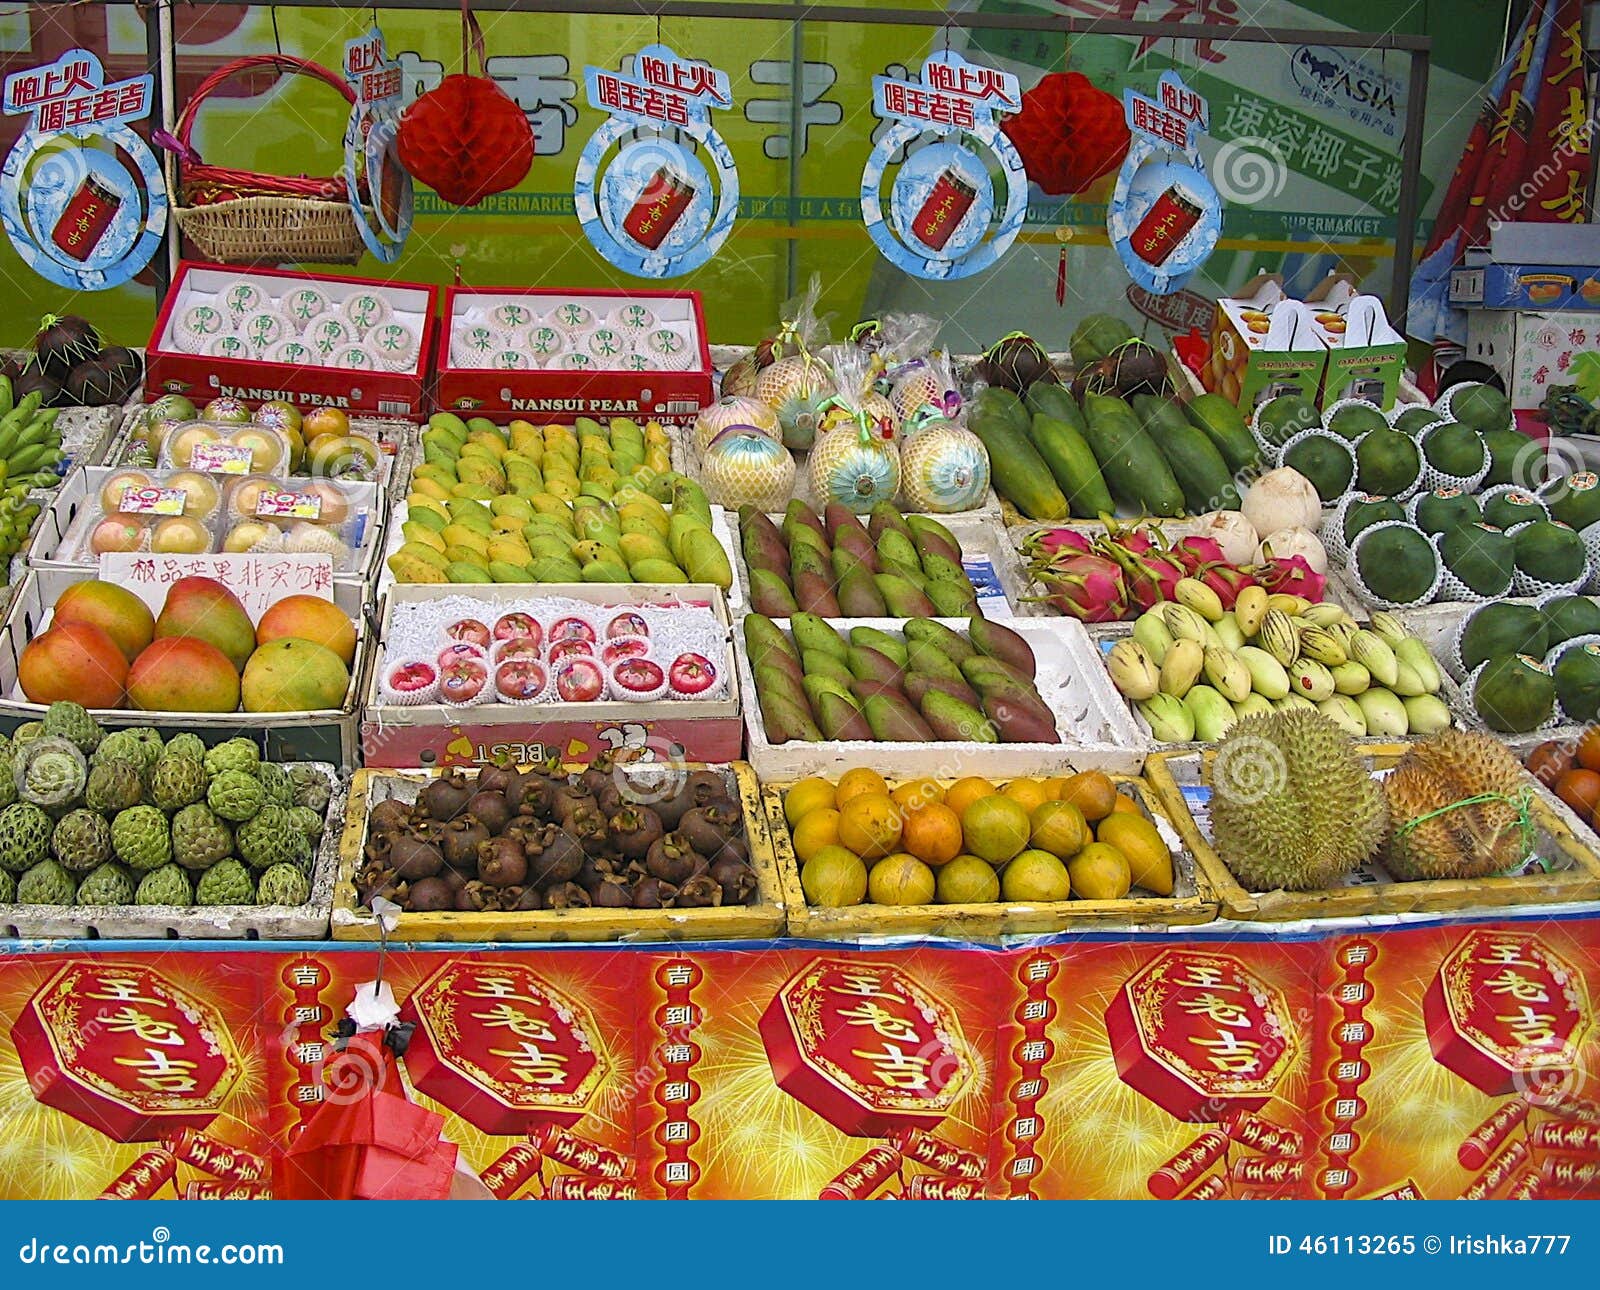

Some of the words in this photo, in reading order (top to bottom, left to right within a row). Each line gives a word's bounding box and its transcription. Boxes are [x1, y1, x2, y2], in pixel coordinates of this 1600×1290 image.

[13, 61, 99, 107] 怕上火
[597, 74, 689, 125] 喝王老吉
[642, 56, 731, 105] 怕上火
[928, 62, 1018, 106] 怕上火
[39, 83, 144, 133] 喝王老吉
[884, 84, 975, 129] 喝王老吉
[1133, 97, 1186, 150] 喝王老吉
[1161, 82, 1206, 129] 怕上火
[1281, 215, 1381, 235] SUPERMARKET
[1257, 361, 1316, 370] ORANGES
[1337, 354, 1397, 368] ORANGES
[220, 385, 294, 402] NANSUI
[300, 393, 350, 408] PEAR
[512, 398, 583, 411] NANSUI
[592, 399, 639, 412] PEAR
[472, 743, 544, 764] BEST
[1173, 965, 1261, 1073] 王老吉
[1479, 944, 1557, 1049] 王老吉
[85, 977, 198, 1093] 王老吉
[292, 965, 326, 1132] 吉到福到
[463, 976, 569, 1085] 王老吉
[829, 973, 931, 1091] 王老吉
[665, 965, 693, 1182] 吉到福到团圆
[1325, 945, 1370, 1187] 吉到福到团圆到
